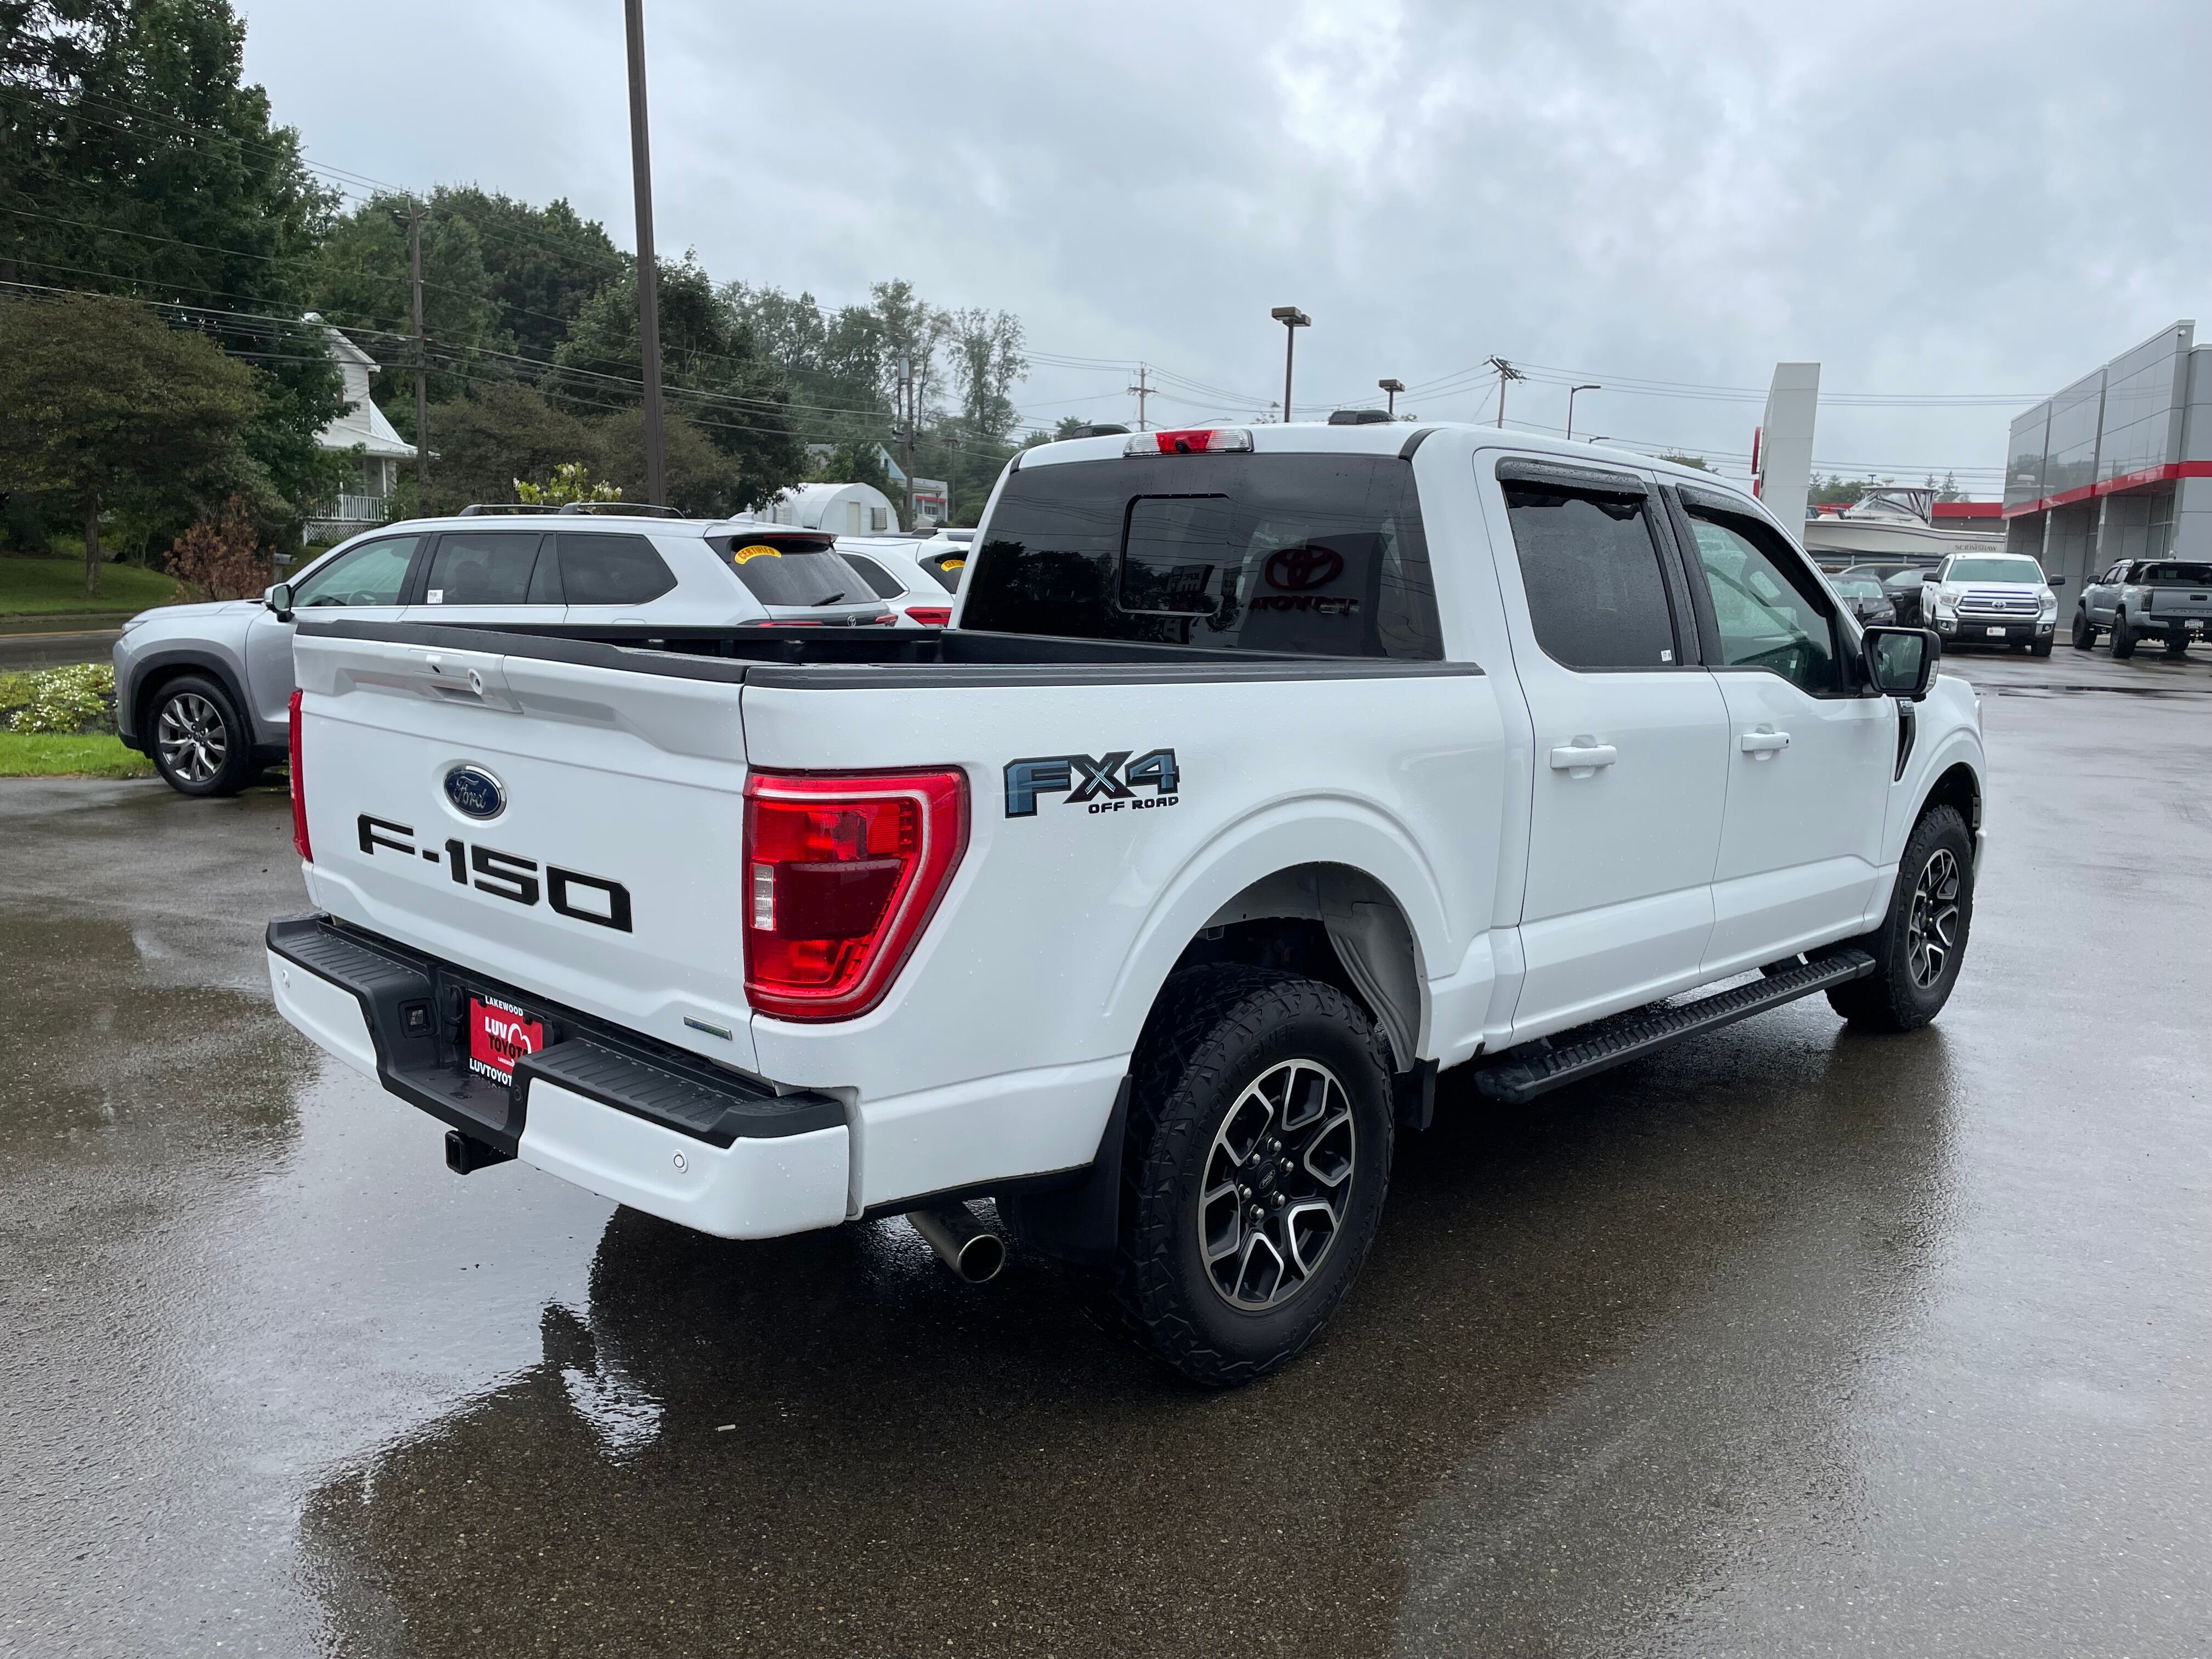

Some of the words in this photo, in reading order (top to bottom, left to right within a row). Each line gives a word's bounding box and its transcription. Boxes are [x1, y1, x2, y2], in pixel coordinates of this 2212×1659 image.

[453, 775, 487, 809] Ford
[1002, 748, 1180, 819] FX4
[1088, 801, 1125, 814] OFF
[1132, 796, 1179, 810] ROAD
[357, 812, 633, 934] F-150
[485, 995, 523, 1017] LAKEWOOD
[485, 1016, 507, 1040] LUV
